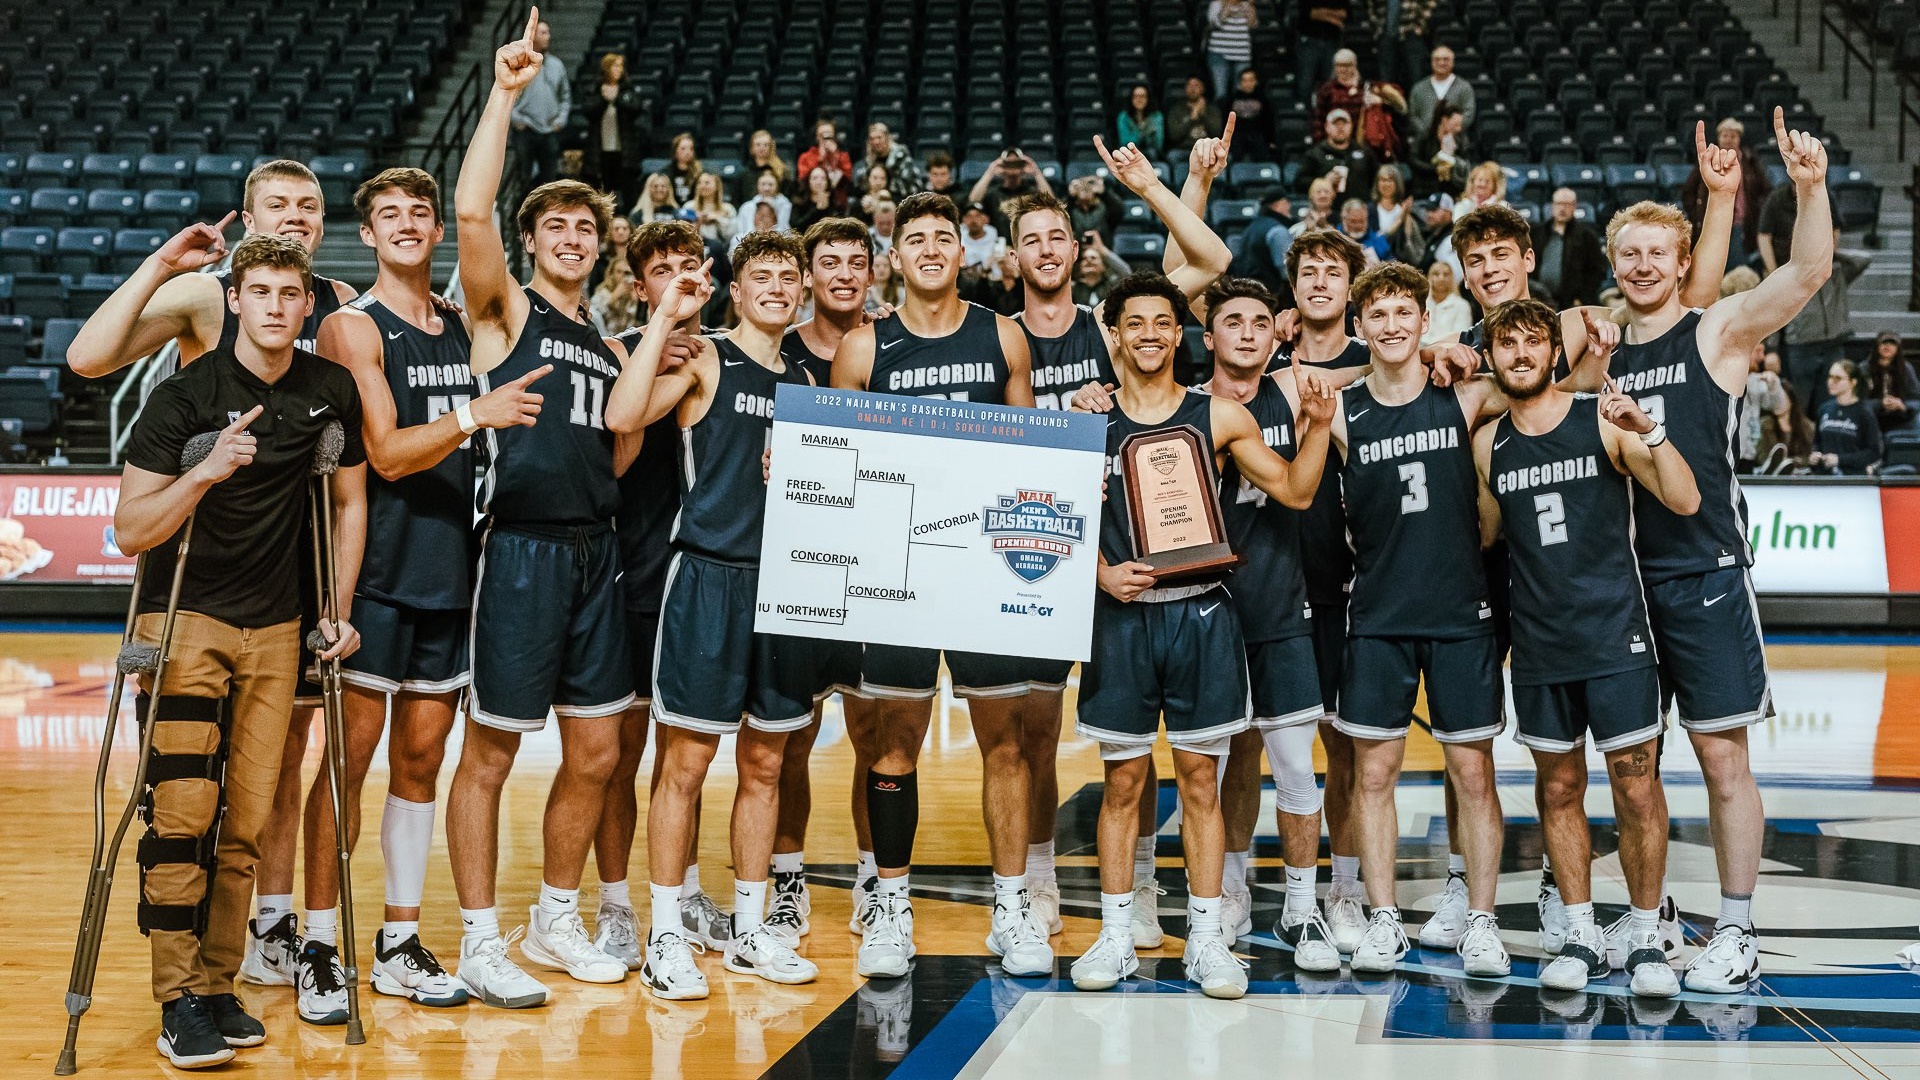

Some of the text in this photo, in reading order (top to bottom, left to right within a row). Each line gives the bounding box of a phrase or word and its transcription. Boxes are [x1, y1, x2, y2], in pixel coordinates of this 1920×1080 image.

[407, 363, 474, 388] CONCORD
[889, 362, 996, 391] CONCORDIA
[1031, 358, 1100, 388] NCORDIA
[1601, 362, 1686, 394] NCORDIA
[570, 370, 604, 430] 11
[815, 394, 1069, 429] 2022 NAIA MEN'S BASKETBALL OPENING ROUNDS
[955, 421, 986, 434] SOKOL
[991, 425, 1025, 438] ARENA
[801, 433, 849, 447] MARIAN
[1358, 426, 1459, 465] CONCORDIA
[858, 469, 906, 483] MARIAN
[1497, 455, 1599, 495] CONCORDIA
[787, 479, 826, 491] FREED-
[1398, 461, 1429, 515] 3
[785, 491, 853, 506] HARDEMAN
[1018, 491, 1053, 507] NAIA
[1160, 504, 1188, 514] OPENING
[1164, 511, 1186, 520] ROUND
[913, 512, 979, 536] CONCORDIA
[988, 511, 1080, 538] BASKETBALL
[1160, 517, 1193, 527] CHAMPION
[1533, 492, 1569, 547] 2
[1770, 510, 1836, 549] Inn
[996, 539, 1069, 553] OPENING ROUND
[790, 549, 859, 566] CONCORDIA
[1020, 554, 1043, 563] OMAHA
[1015, 562, 1047, 571] NEBRASKA
[848, 585, 916, 600] CONCORDIA
[758, 602, 849, 618] IU NORTHWEST
